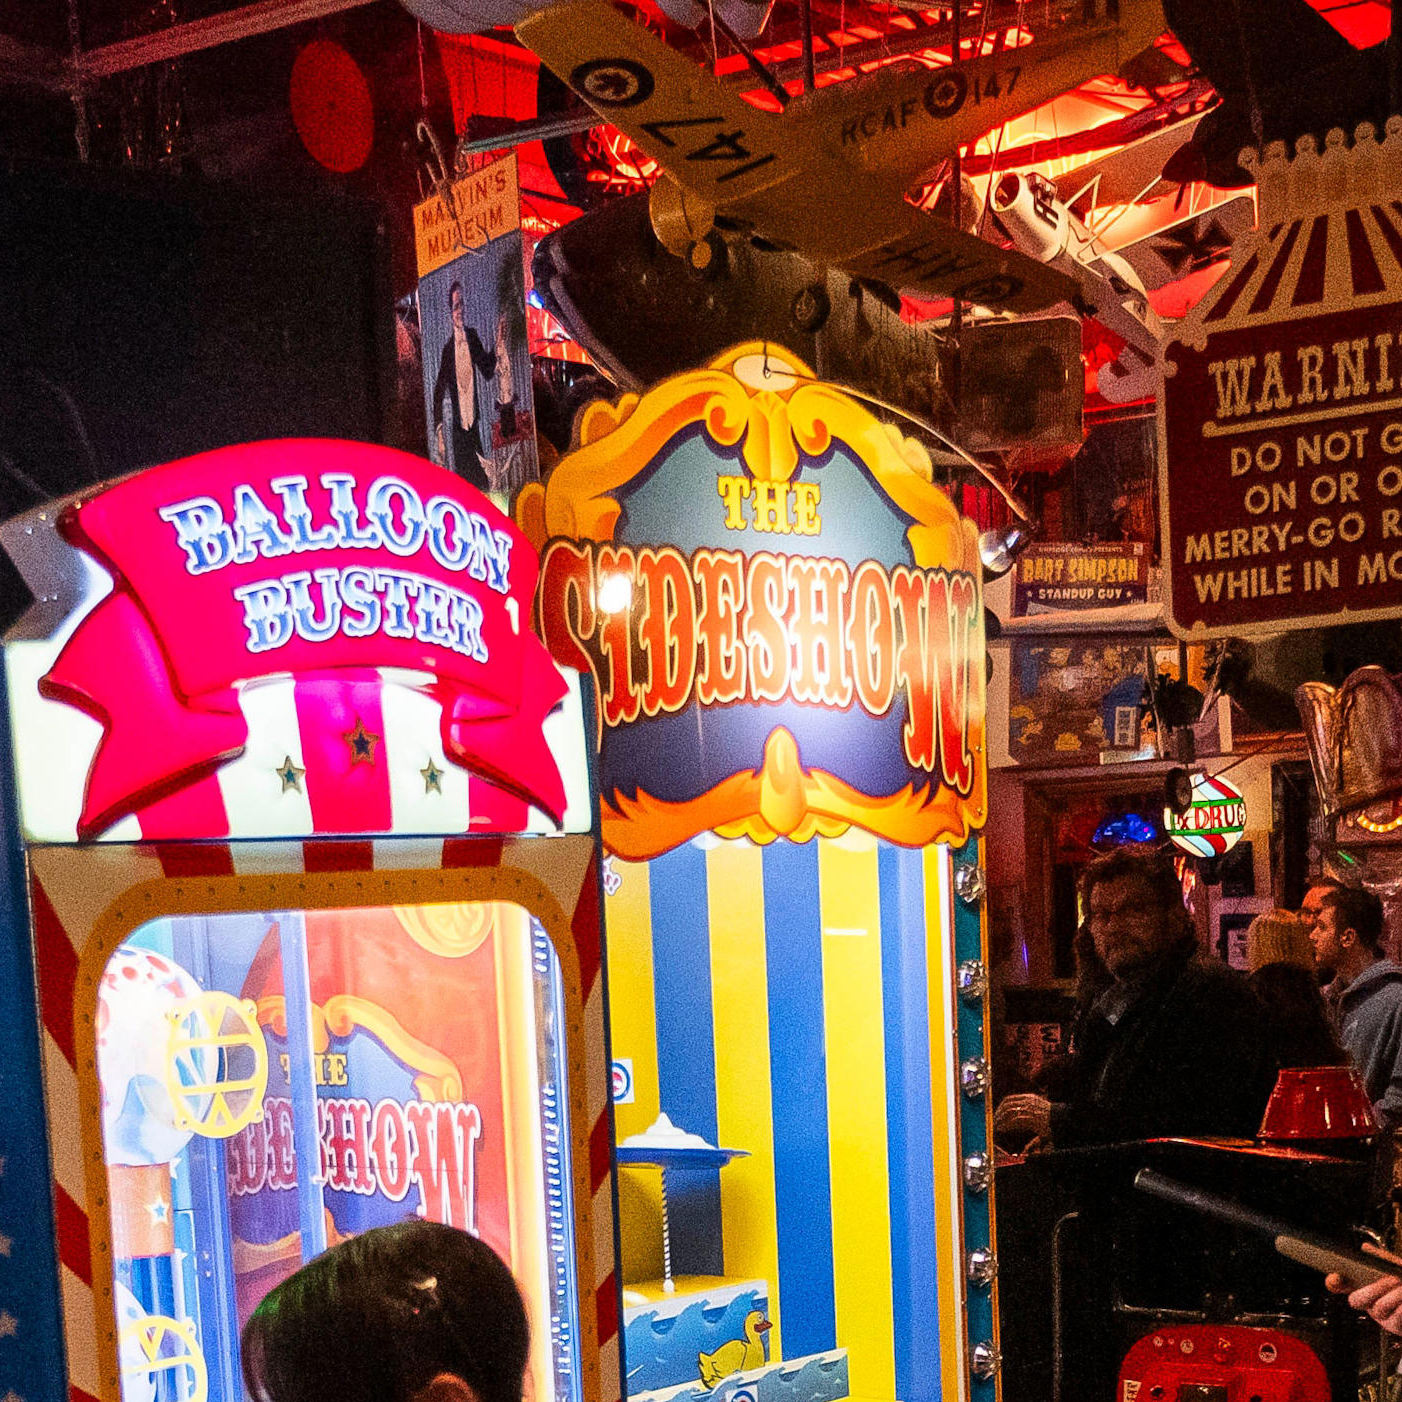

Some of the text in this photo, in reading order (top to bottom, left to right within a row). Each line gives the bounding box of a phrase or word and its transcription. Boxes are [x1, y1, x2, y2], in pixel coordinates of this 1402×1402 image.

[422, 169, 506, 232] MAVIN'S
[1231, 441, 1282, 477] DO
[1296, 428, 1369, 467] NOT
[717, 473, 822, 537] THE
[1244, 481, 1297, 514] ON
[1310, 471, 1360, 505] OR
[159, 472, 513, 595] BALLOON
[1184, 511, 1366, 564] MERRY-GO
[1023, 555, 1139, 583] BART SIMPSON
[1039, 588, 1095, 600] STANDUP
[1098, 588, 1123, 600] GUY
[1193, 563, 1292, 604] WHILE
[1303, 558, 1339, 592] IN
[234, 566, 490, 664] BUSTER
[540, 540, 979, 794] SIDESHOW
